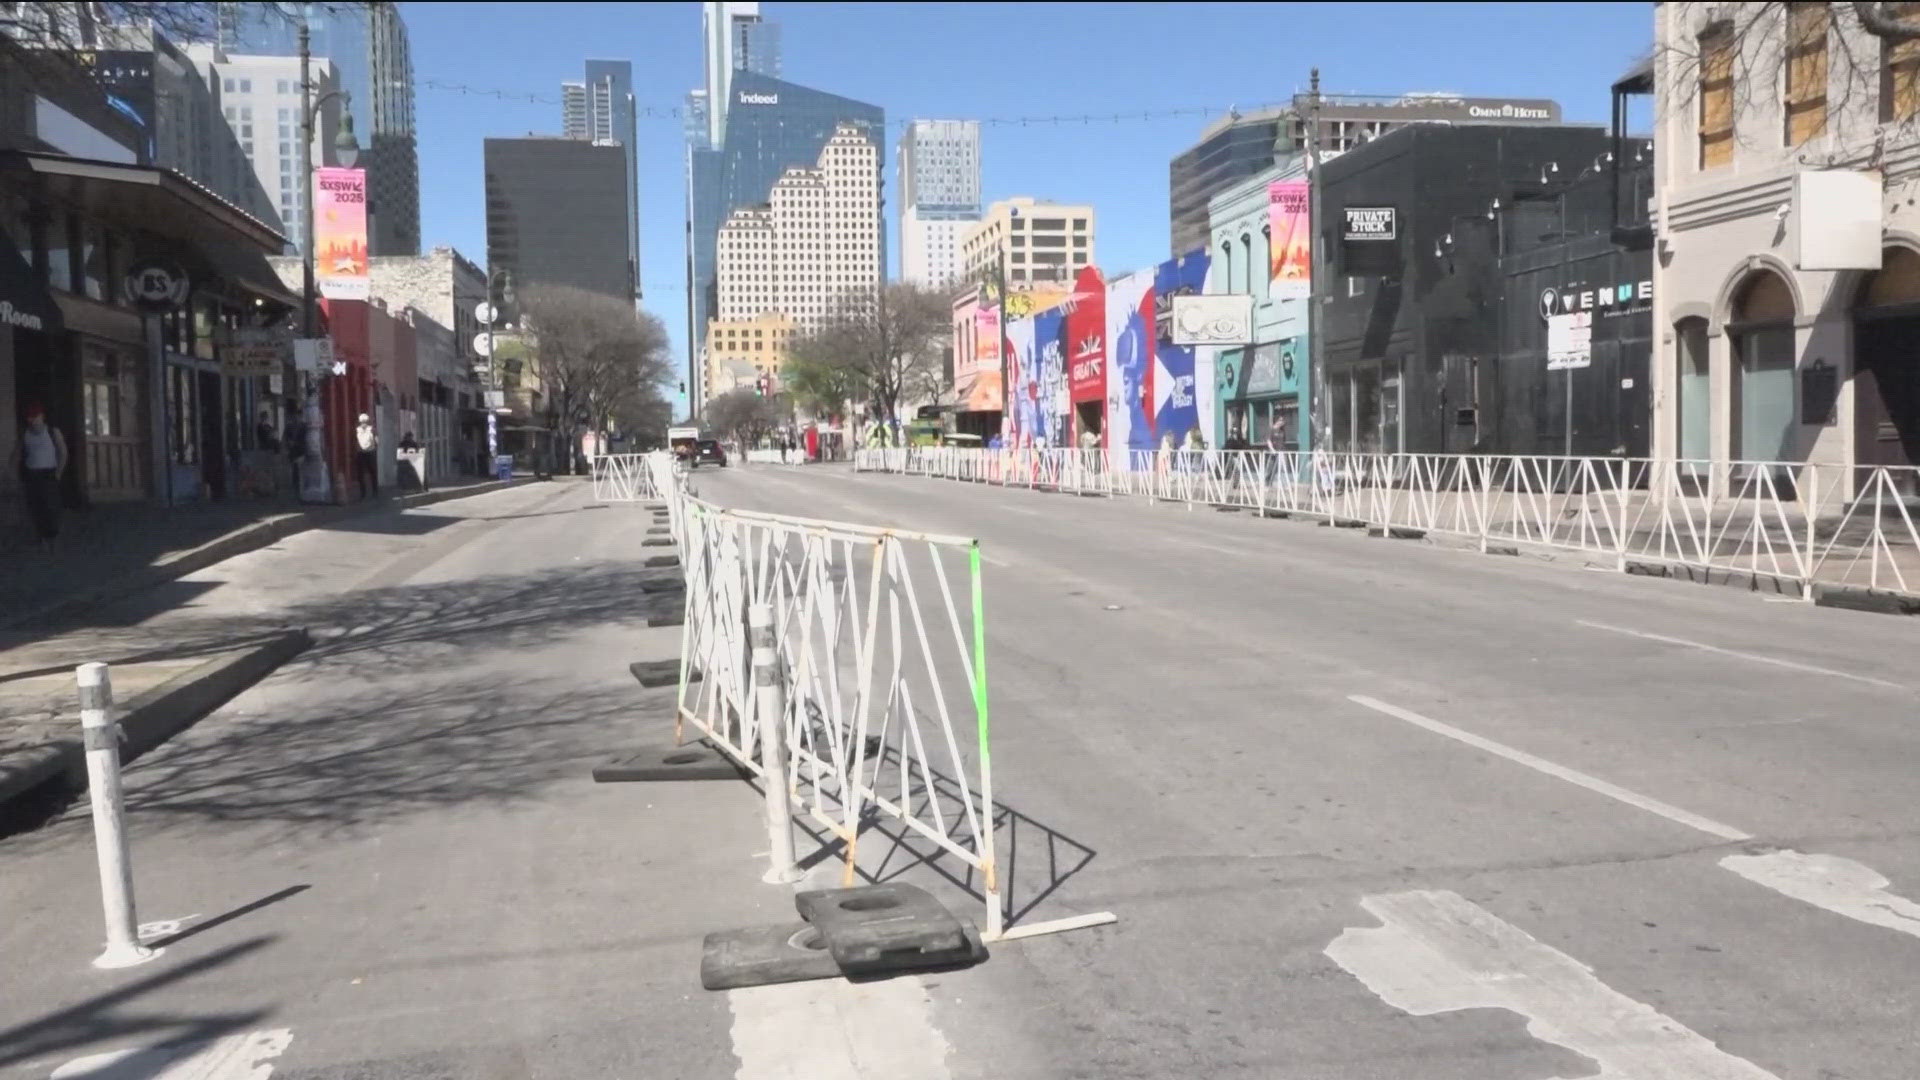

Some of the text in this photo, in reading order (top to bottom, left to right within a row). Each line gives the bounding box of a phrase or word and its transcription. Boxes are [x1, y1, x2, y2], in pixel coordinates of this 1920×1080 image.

[334, 192, 364, 203] 2025
[1346, 211, 1392, 222] PRIVATE
[1351, 221, 1386, 232] STOCK
[1562, 280, 1653, 311] VENUE
[0, 300, 43, 331] Room
